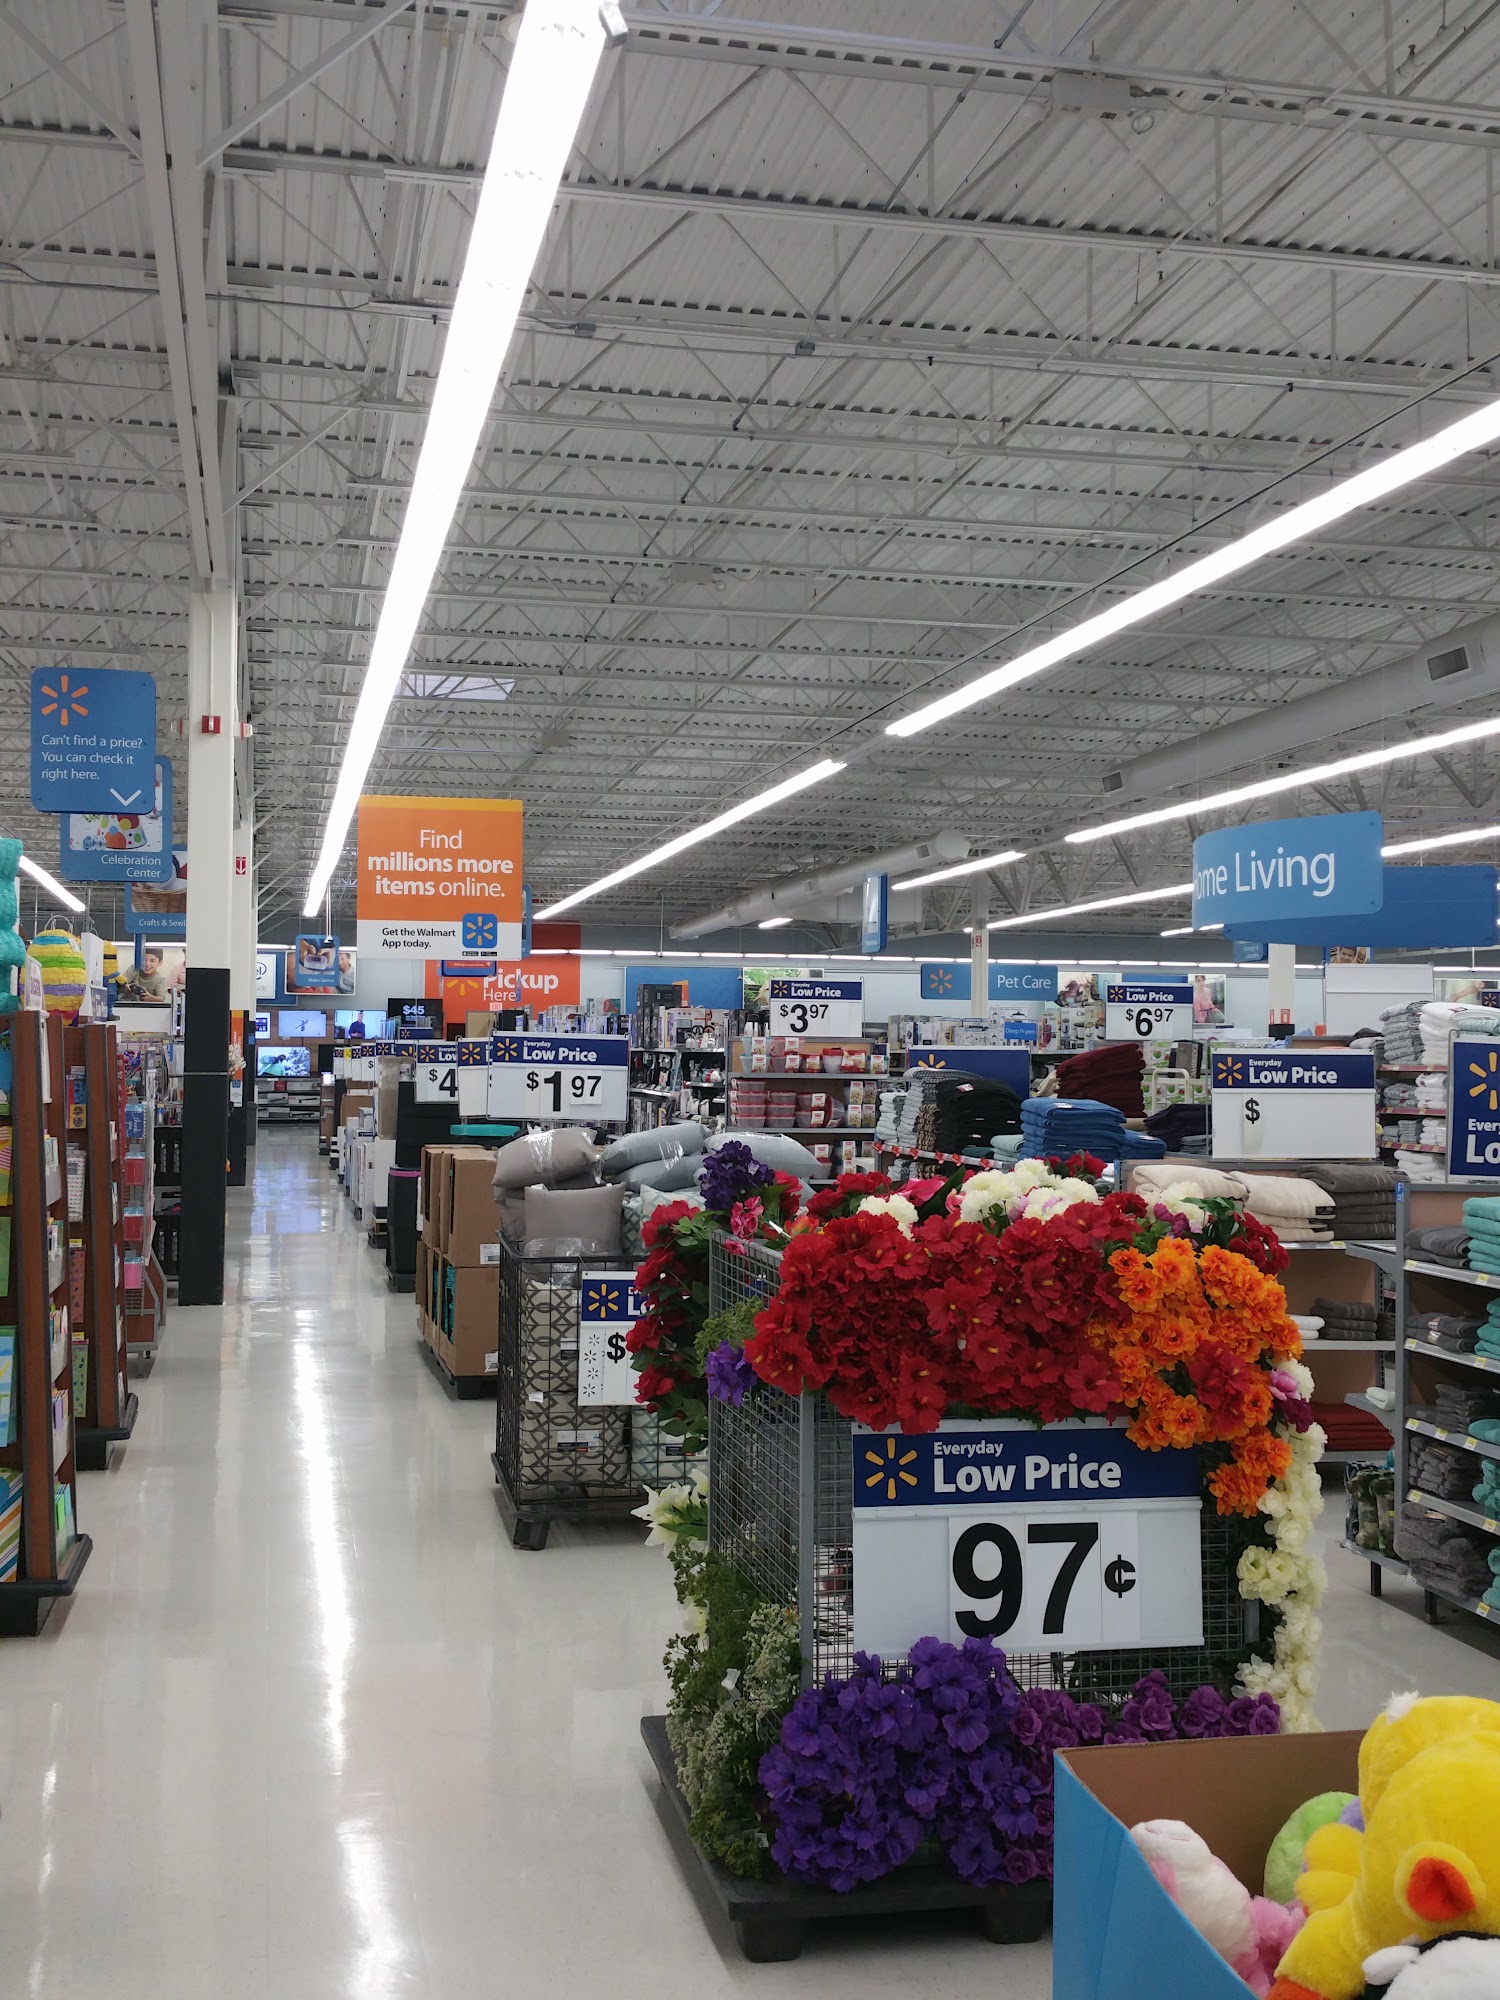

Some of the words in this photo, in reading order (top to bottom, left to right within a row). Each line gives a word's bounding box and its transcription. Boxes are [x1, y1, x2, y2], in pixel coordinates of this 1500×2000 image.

[41, 734, 70, 746] Can't
[73, 734, 96, 746] find
[100, 738, 106, 746] a
[110, 738, 142, 749] price?
[41, 752, 62, 762] You
[66, 753, 86, 763] can
[90, 752, 124, 764] check
[126, 754, 134, 764] it
[41, 768, 68, 782] right
[71, 768, 100, 780] here.
[420, 830, 462, 849] Find
[101, 855, 161, 865] Celebration
[368, 852, 453, 872] millions
[457, 858, 514, 874] more
[126, 868, 161, 878] Center
[1236, 847, 1335, 896] Living
[376, 874, 435, 896] items
[438, 877, 506, 897] online.
[382, 927, 399, 936] Get
[400, 927, 416, 936] the
[417, 928, 456, 937] Walmart
[382, 939, 401, 949] App
[403, 939, 432, 949] today.
[483, 968, 559, 994] Pickup
[997, 975, 1019, 988] Pet
[1022, 975, 1051, 989] Care
[483, 988, 517, 1001] Here
[791, 987, 814, 996] Low
[815, 987, 842, 997] Price
[1126, 991, 1148, 1001] Low
[1149, 992, 1174, 1002] Price
[403, 1005, 425, 1015] $45
[523, 1040, 551, 1048] Everyday
[523, 1046, 556, 1060] Low
[558, 1047, 598, 1062] Price
[1249, 1059, 1282, 1068] Everyday
[1249, 1067, 1288, 1084] Low
[1291, 1066, 1338, 1084] Price
[1245, 1097, 1260, 1124] $
[607, 1332, 626, 1364] $
[932, 1440, 1004, 1458] Everyday
[932, 1458, 1016, 1494] Low
[1024, 1453, 1122, 1491] Price
